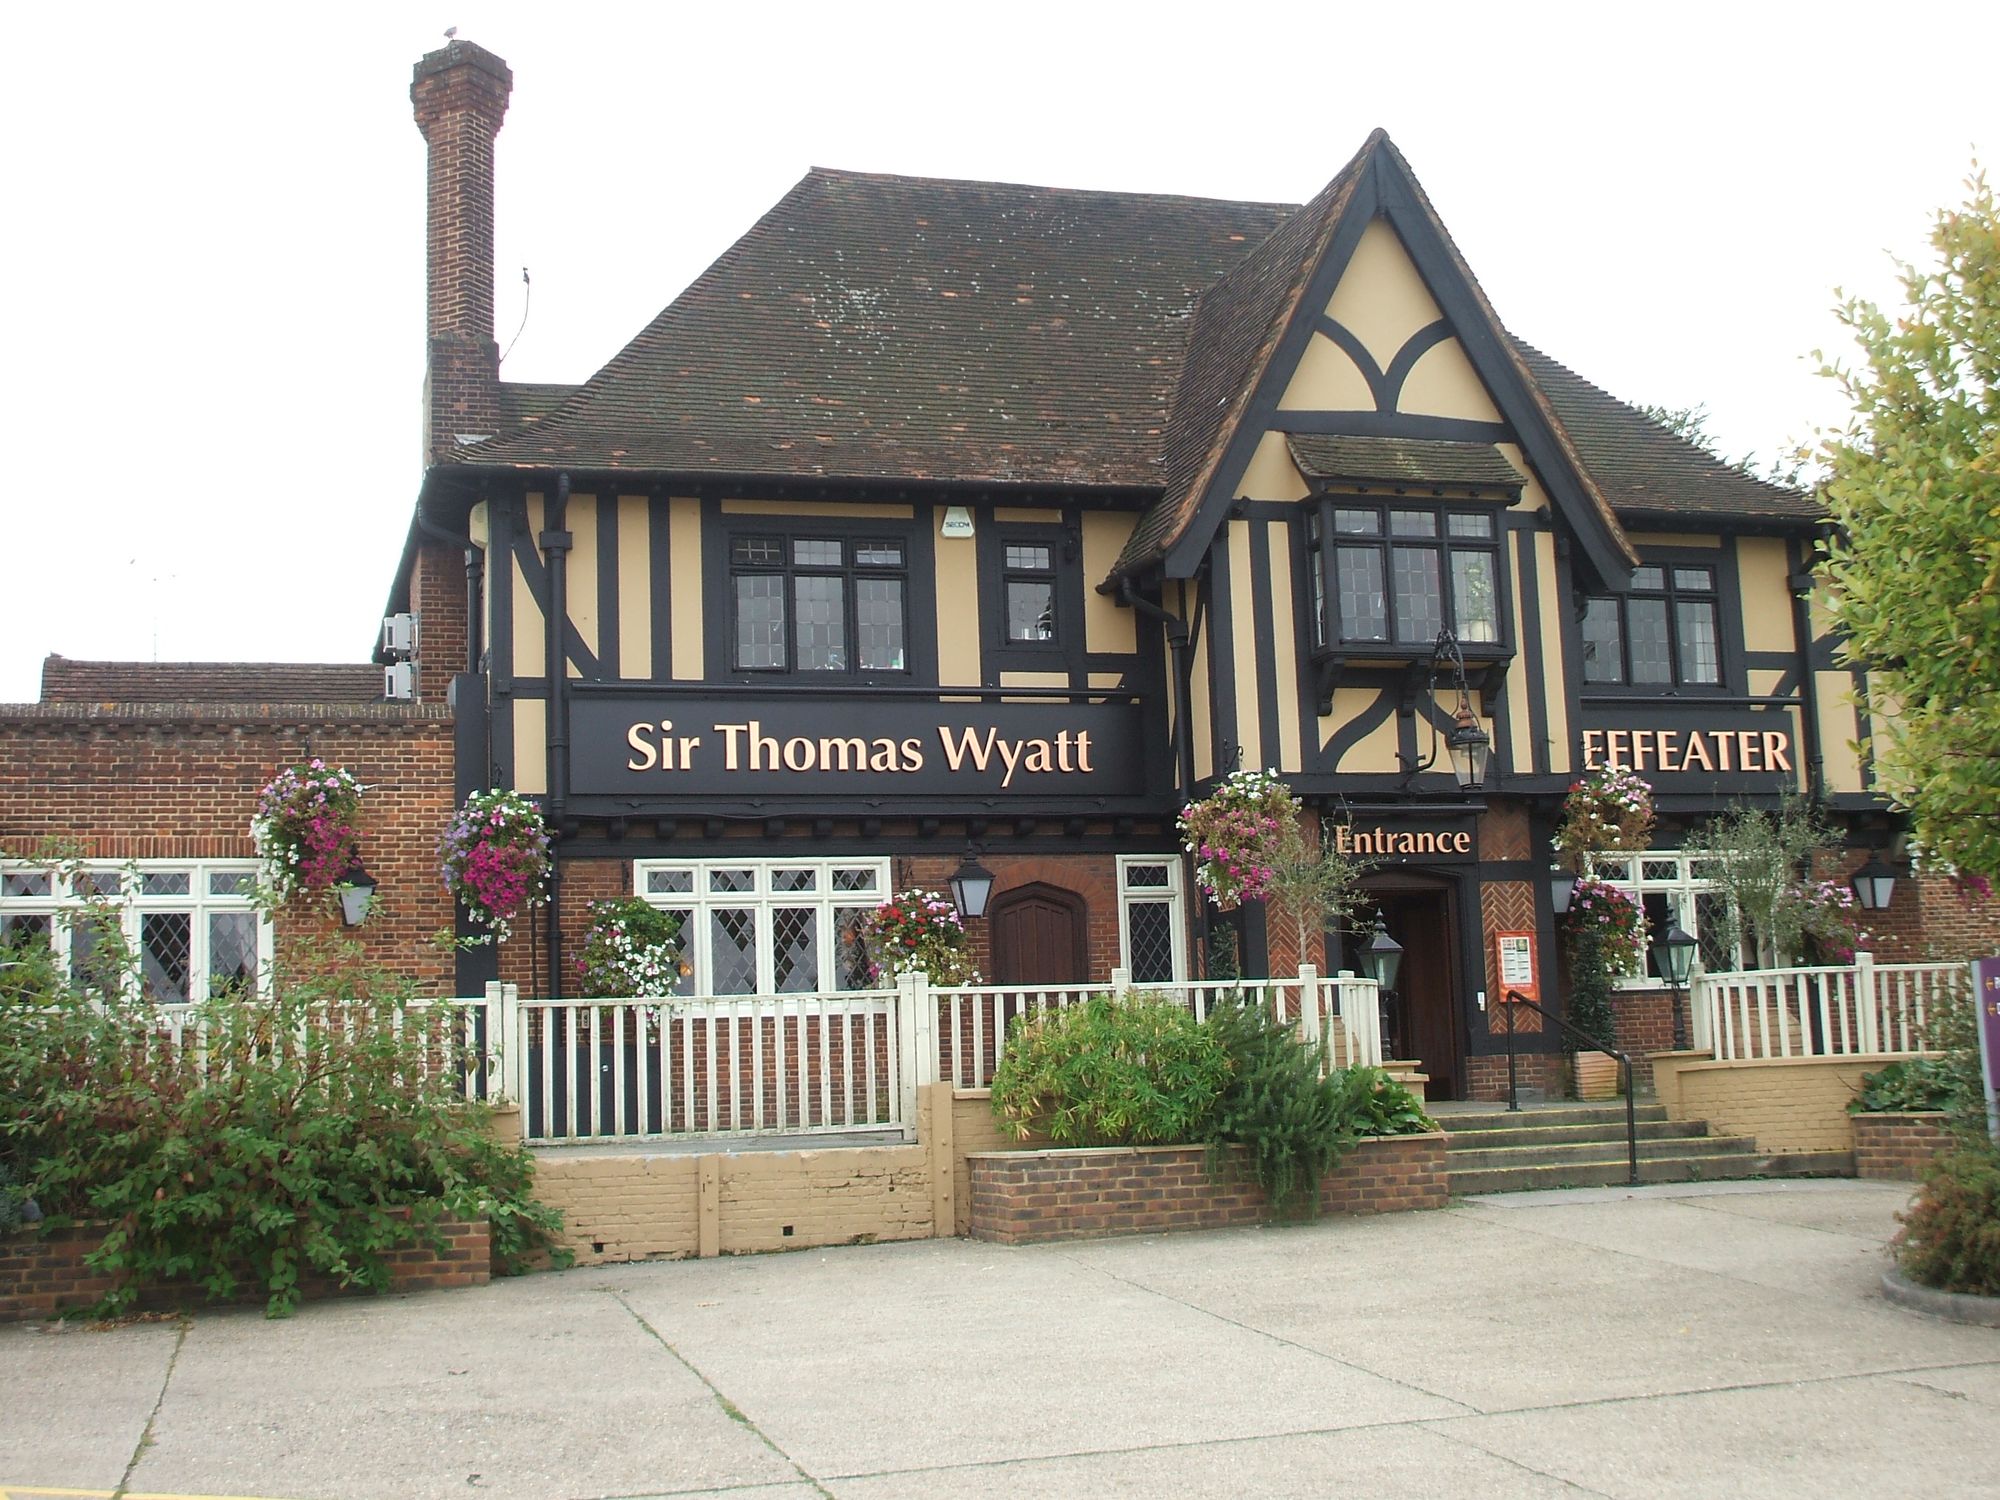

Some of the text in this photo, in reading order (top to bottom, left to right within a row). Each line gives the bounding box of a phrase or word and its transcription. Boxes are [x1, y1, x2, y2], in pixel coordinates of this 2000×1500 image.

[627, 720, 1094, 788] Sir Thomas Wyatt
[1582, 730, 1792, 772] EEFEATER
[1335, 824, 1471, 854] Entrance
